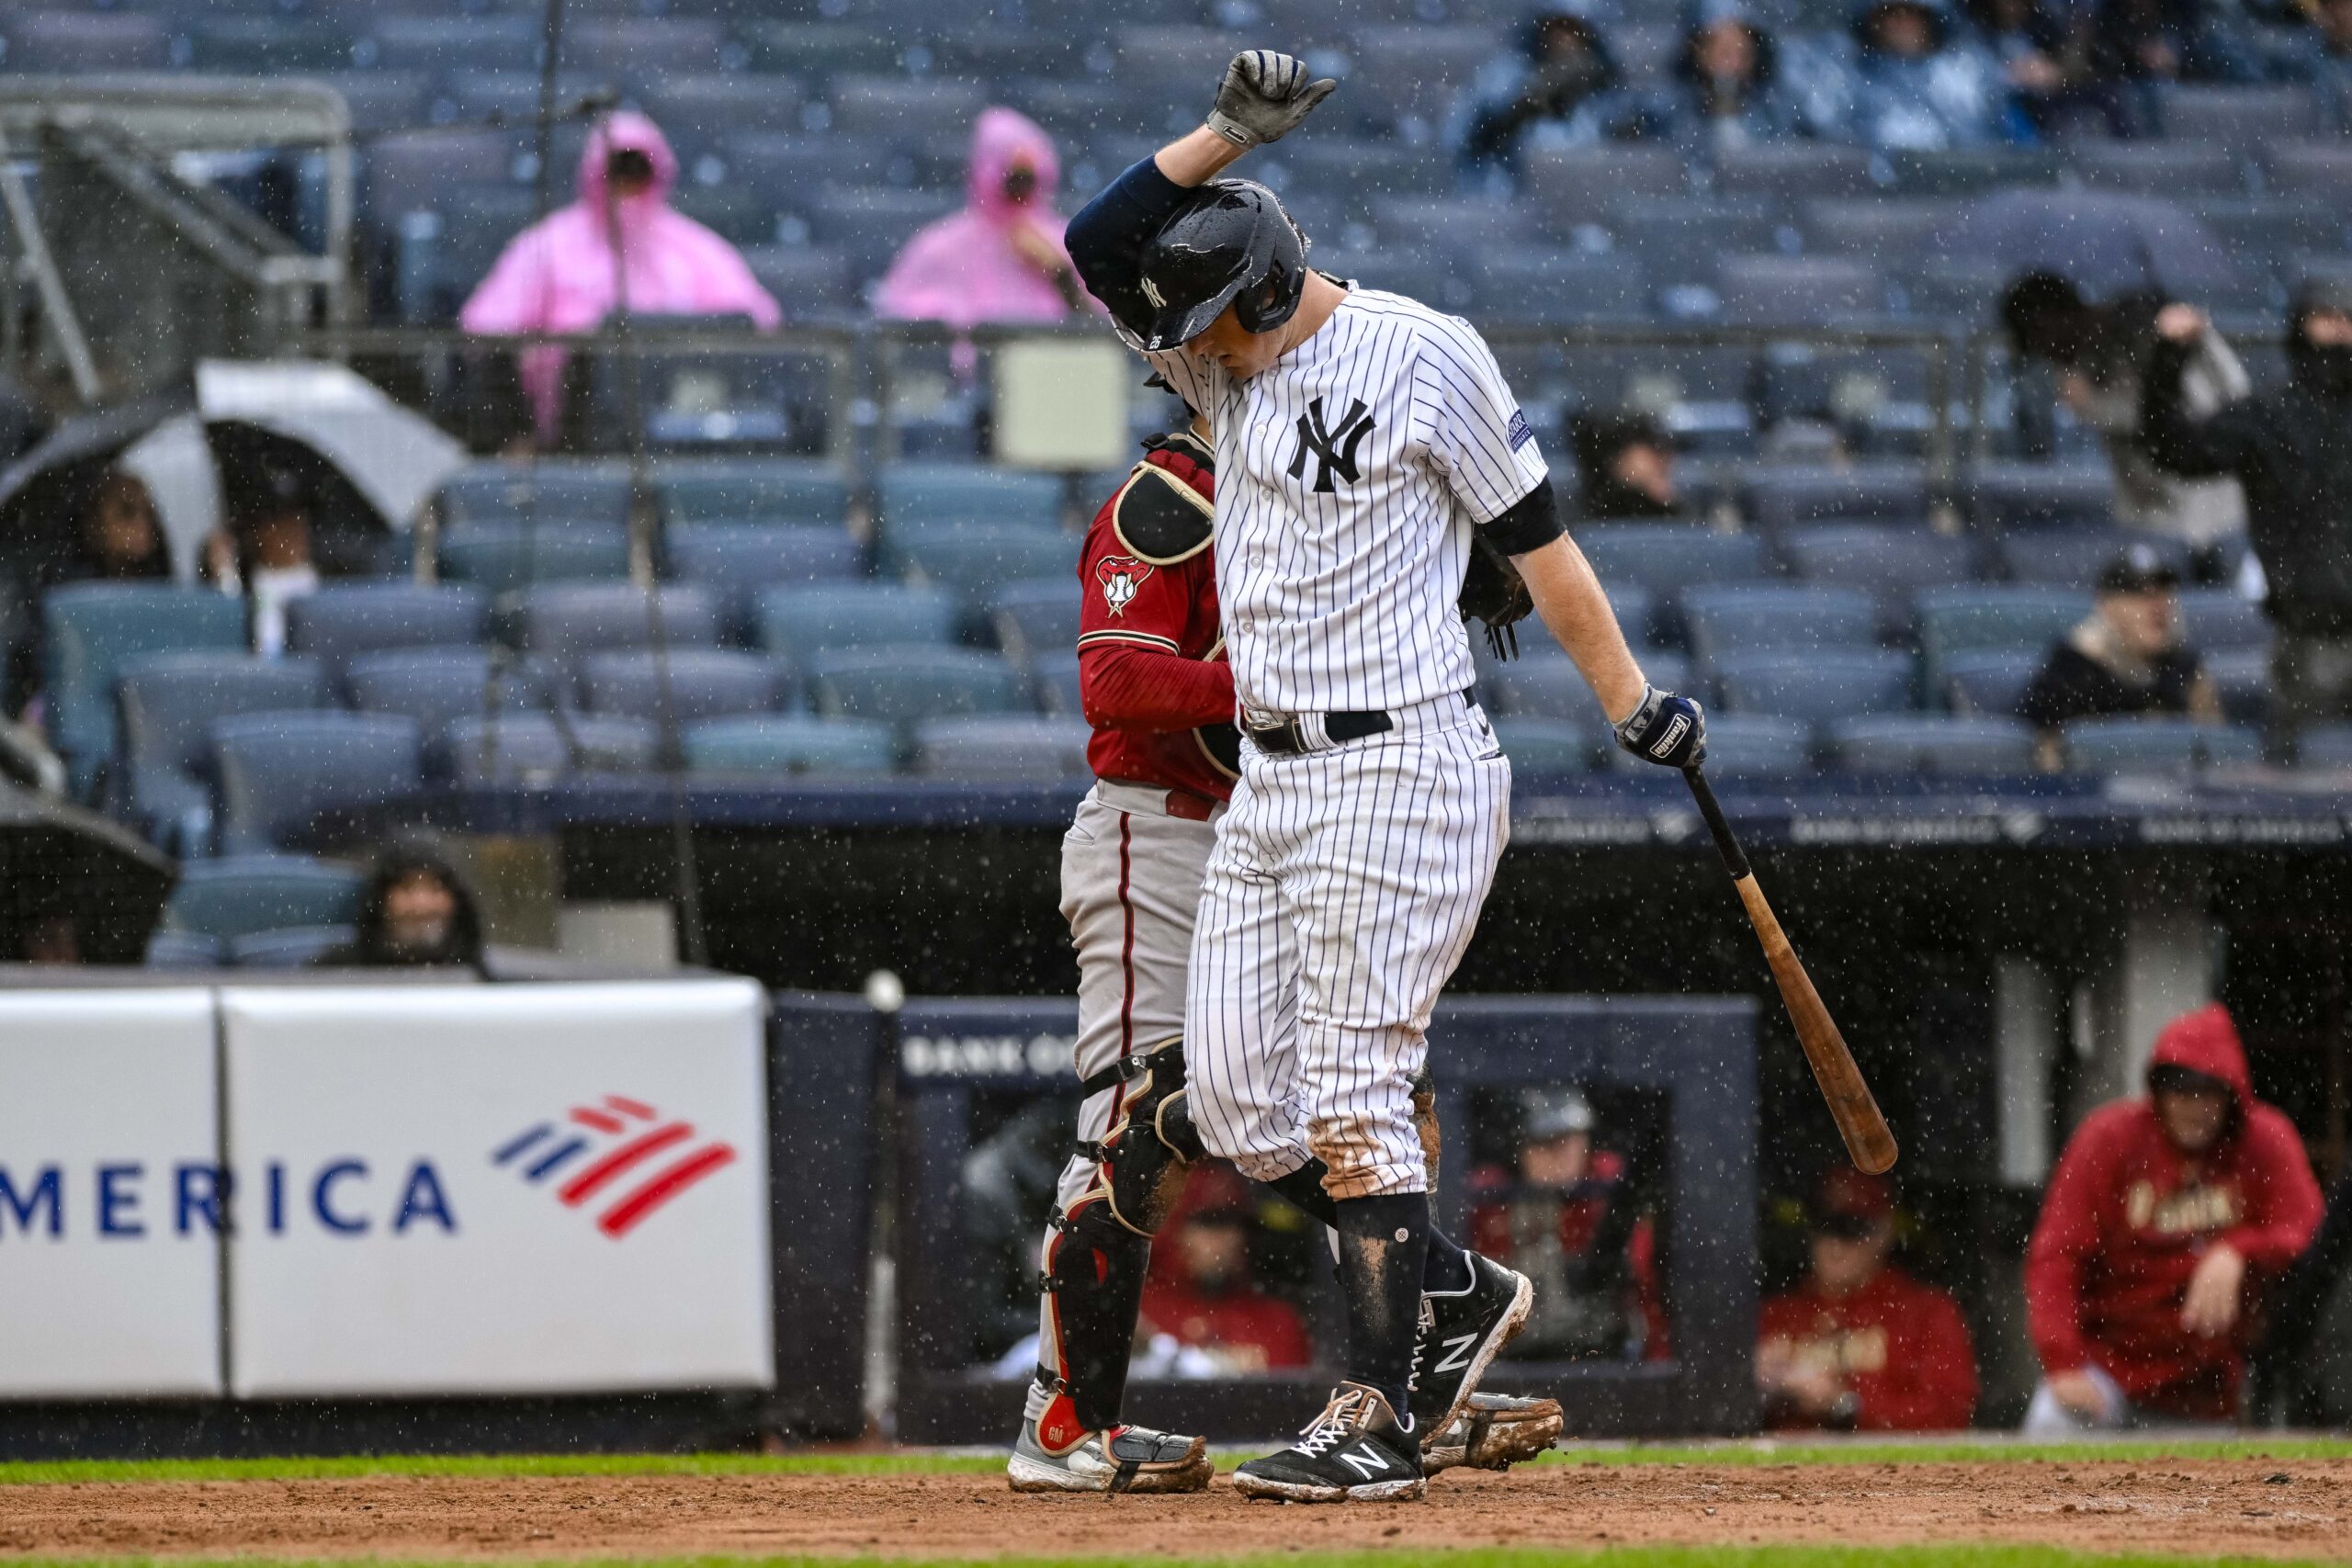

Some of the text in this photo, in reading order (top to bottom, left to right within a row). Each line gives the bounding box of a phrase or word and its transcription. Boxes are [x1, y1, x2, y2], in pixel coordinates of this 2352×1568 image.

[1148, 335, 1162, 349] 26
[1287, 395, 1377, 492] NY
[1654, 716, 1687, 755] Franklin
[903, 1037, 1025, 1076] BANK
[1434, 1332, 1478, 1373] N
[1340, 1442, 1390, 1481] N
